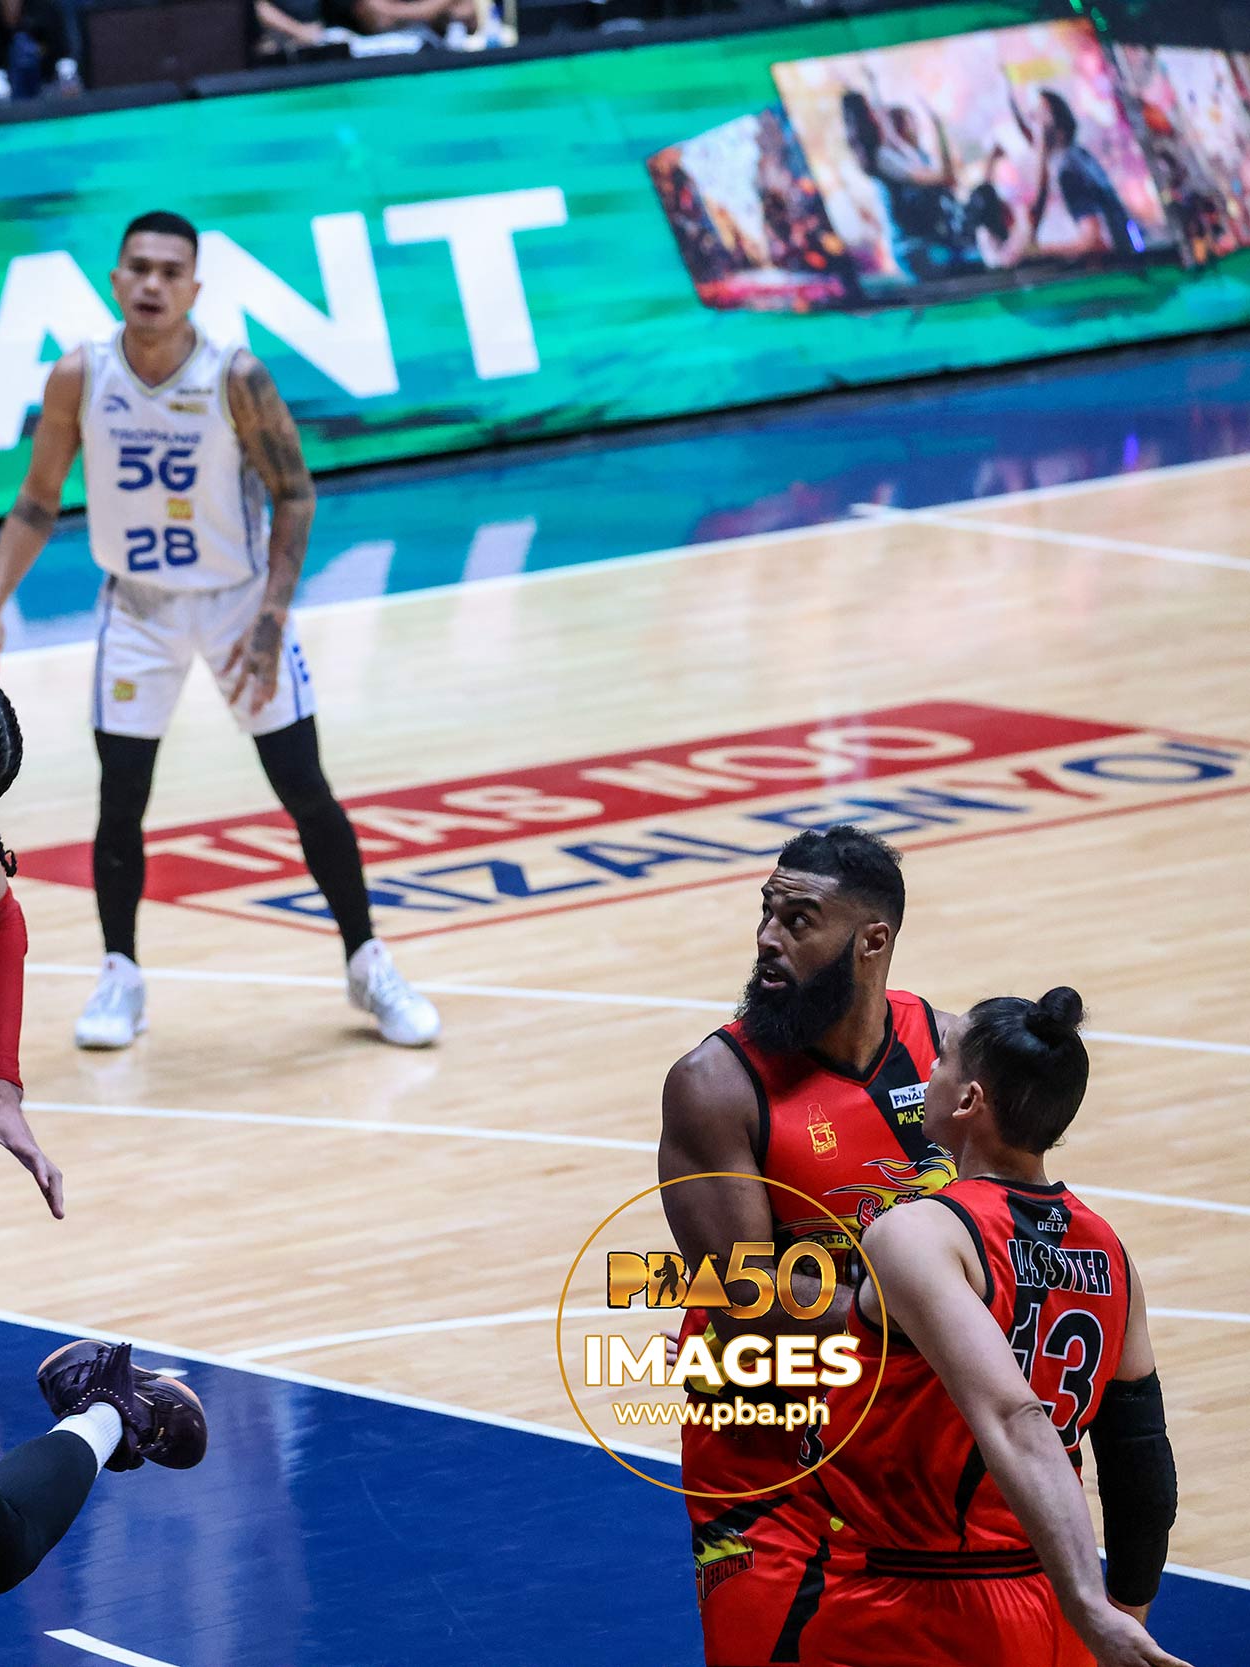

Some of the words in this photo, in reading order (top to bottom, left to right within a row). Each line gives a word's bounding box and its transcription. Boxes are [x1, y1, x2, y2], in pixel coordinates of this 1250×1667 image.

[117, 446, 198, 492] 5G
[125, 526, 199, 572] 28
[144, 785, 605, 873] TAAS
[893, 1088, 927, 1107] FINAL
[1037, 1220, 1068, 1233] DELTA
[1006, 1238, 1112, 1297] LASSITER
[1009, 1302, 1104, 1450] 13
